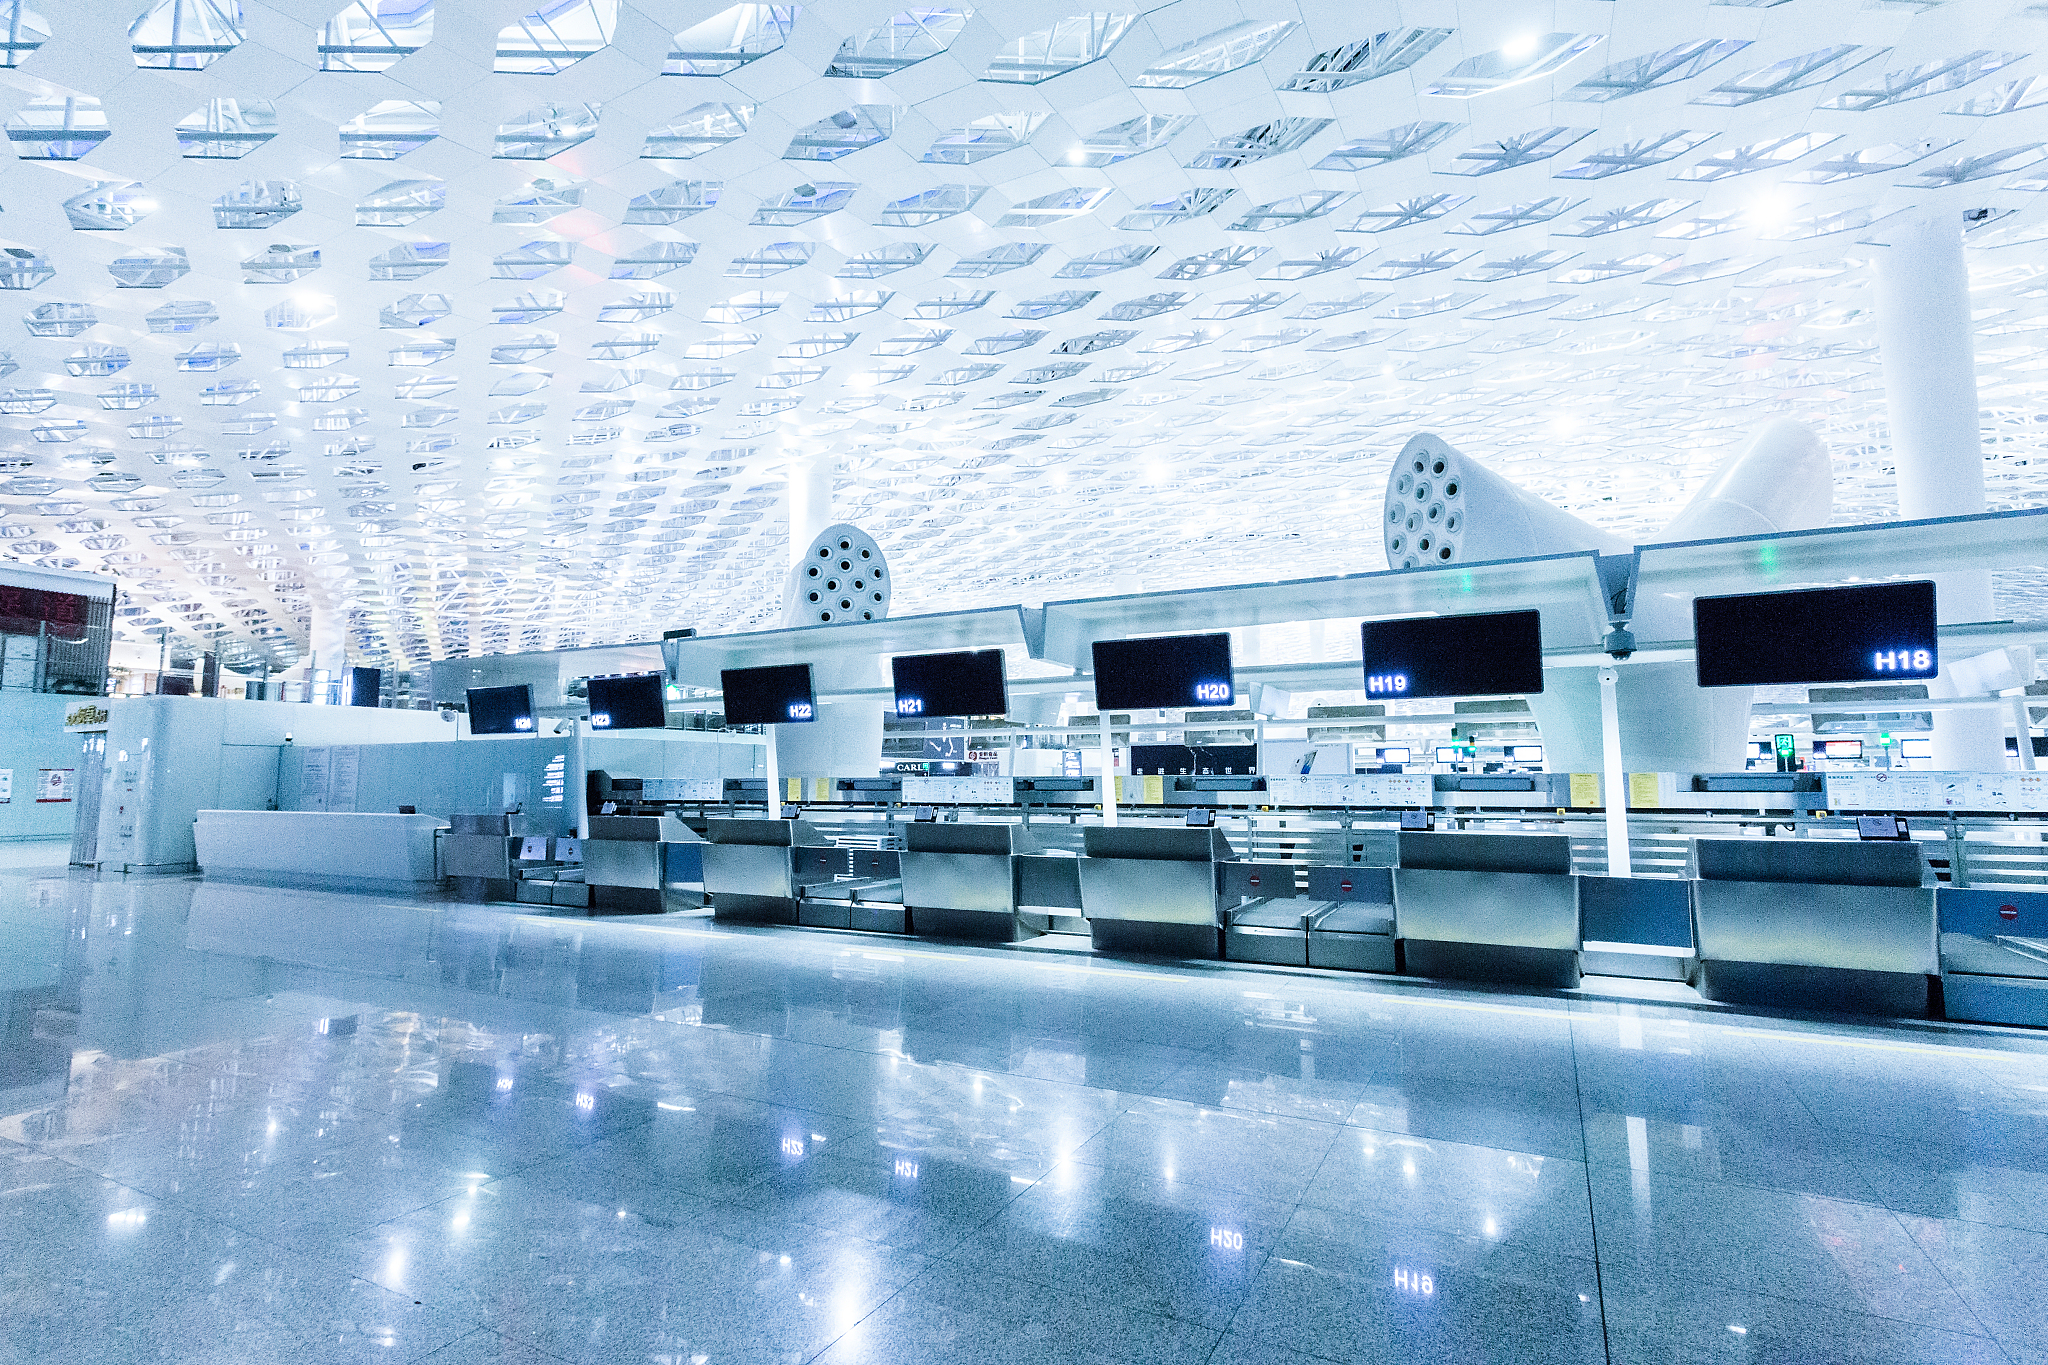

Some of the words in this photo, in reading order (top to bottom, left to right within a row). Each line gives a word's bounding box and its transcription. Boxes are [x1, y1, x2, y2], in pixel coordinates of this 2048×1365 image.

[1876, 650, 1930, 670] H18
[1369, 675, 1406, 692] H19
[1197, 684, 1229, 699] H20
[790, 704, 812, 718] H22
[898, 699, 922, 713] H21
[592, 714, 611, 726] H23
